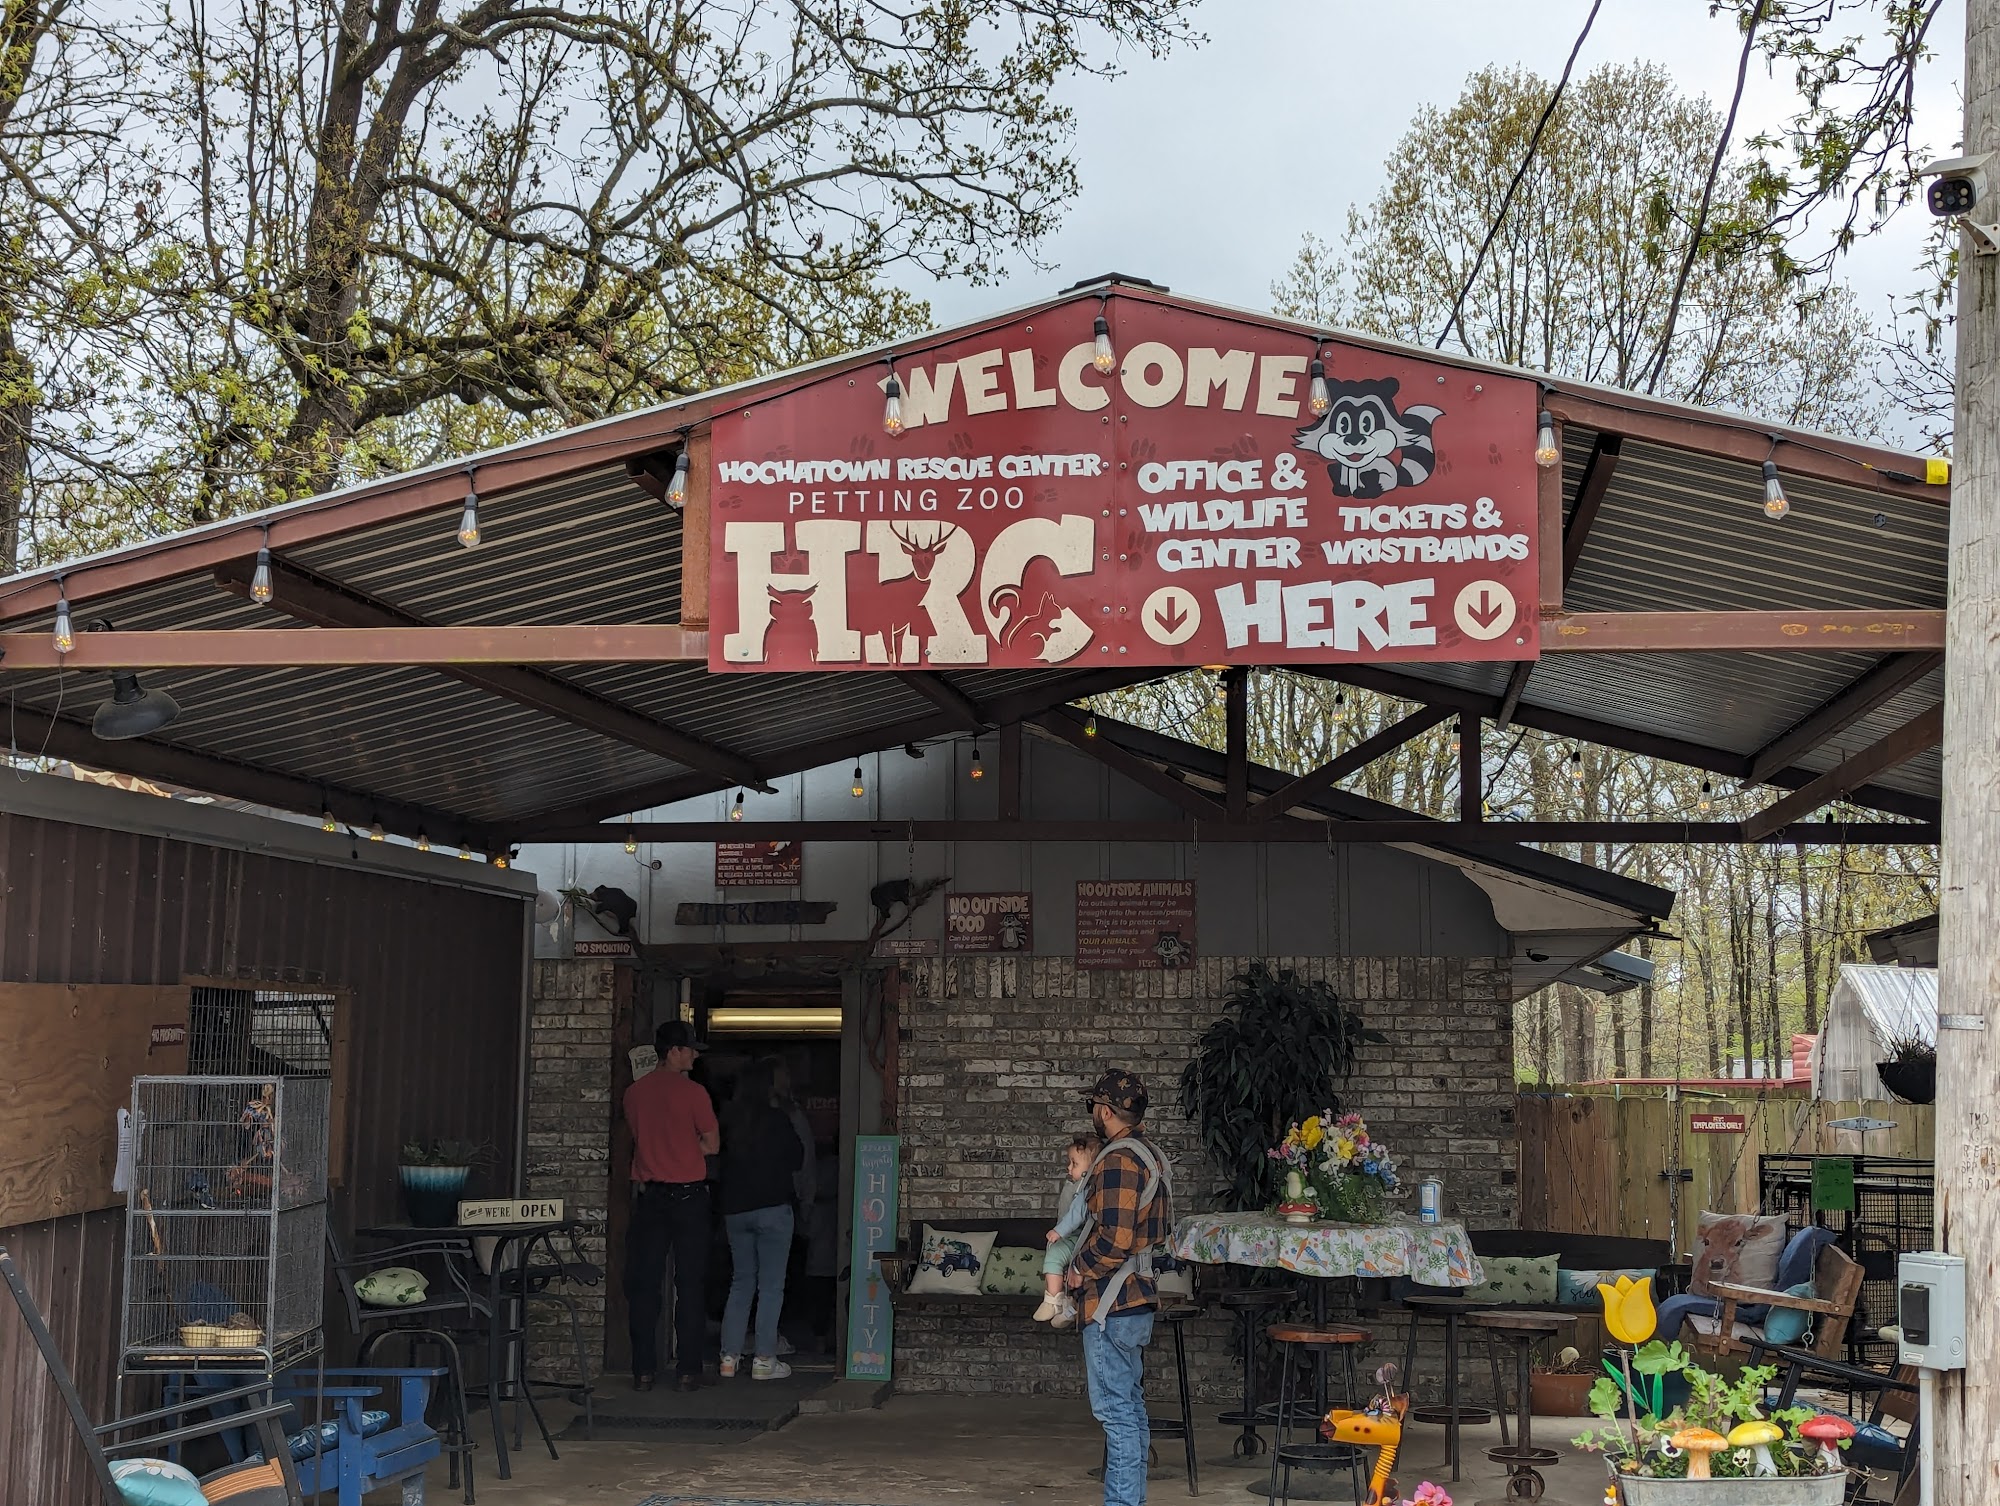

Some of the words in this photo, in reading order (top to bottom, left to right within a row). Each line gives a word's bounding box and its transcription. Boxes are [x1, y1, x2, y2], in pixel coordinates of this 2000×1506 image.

[877, 341, 1308, 429] WELCOME
[718, 459, 890, 484] HOCHATOWN
[897, 456, 993, 481] RESCUE
[998, 453, 1102, 479] CENTER
[1137, 460, 1263, 493] OFFICE
[1270, 453, 1307, 491] &
[789, 489, 938, 514] PETTING
[957, 486, 1024, 510] ZOO
[1137, 497, 1308, 532] WILDLIFE
[1338, 503, 1467, 533] TICKETS
[1472, 497, 1503, 529] &
[1157, 537, 1302, 572] CENTER
[1321, 534, 1529, 565] WRISTBANDS
[723, 515, 1096, 664] HRC
[1215, 578, 1436, 652] HERE
[1078, 883, 1094, 897] NO
[1095, 883, 1141, 897] OUTSIDE
[1143, 882, 1192, 897] ANIMALS
[1150, 900, 1166, 908] may
[950, 897, 970, 914] NO
[971, 896, 1029, 915] OUTSIDE
[1078, 909, 1107, 917] brought
[949, 914, 985, 933] FOOD
[576, 943, 588, 953] NO
[590, 943, 630, 953] SMOKING
[1692, 1121, 1726, 1130] EMPLOYEES
[1727, 1122, 1743, 1130] ONLY
[463, 1208, 477, 1219] Come
[484, 1206, 511, 1217] WE'RE
[521, 1203, 557, 1218] OPEN
